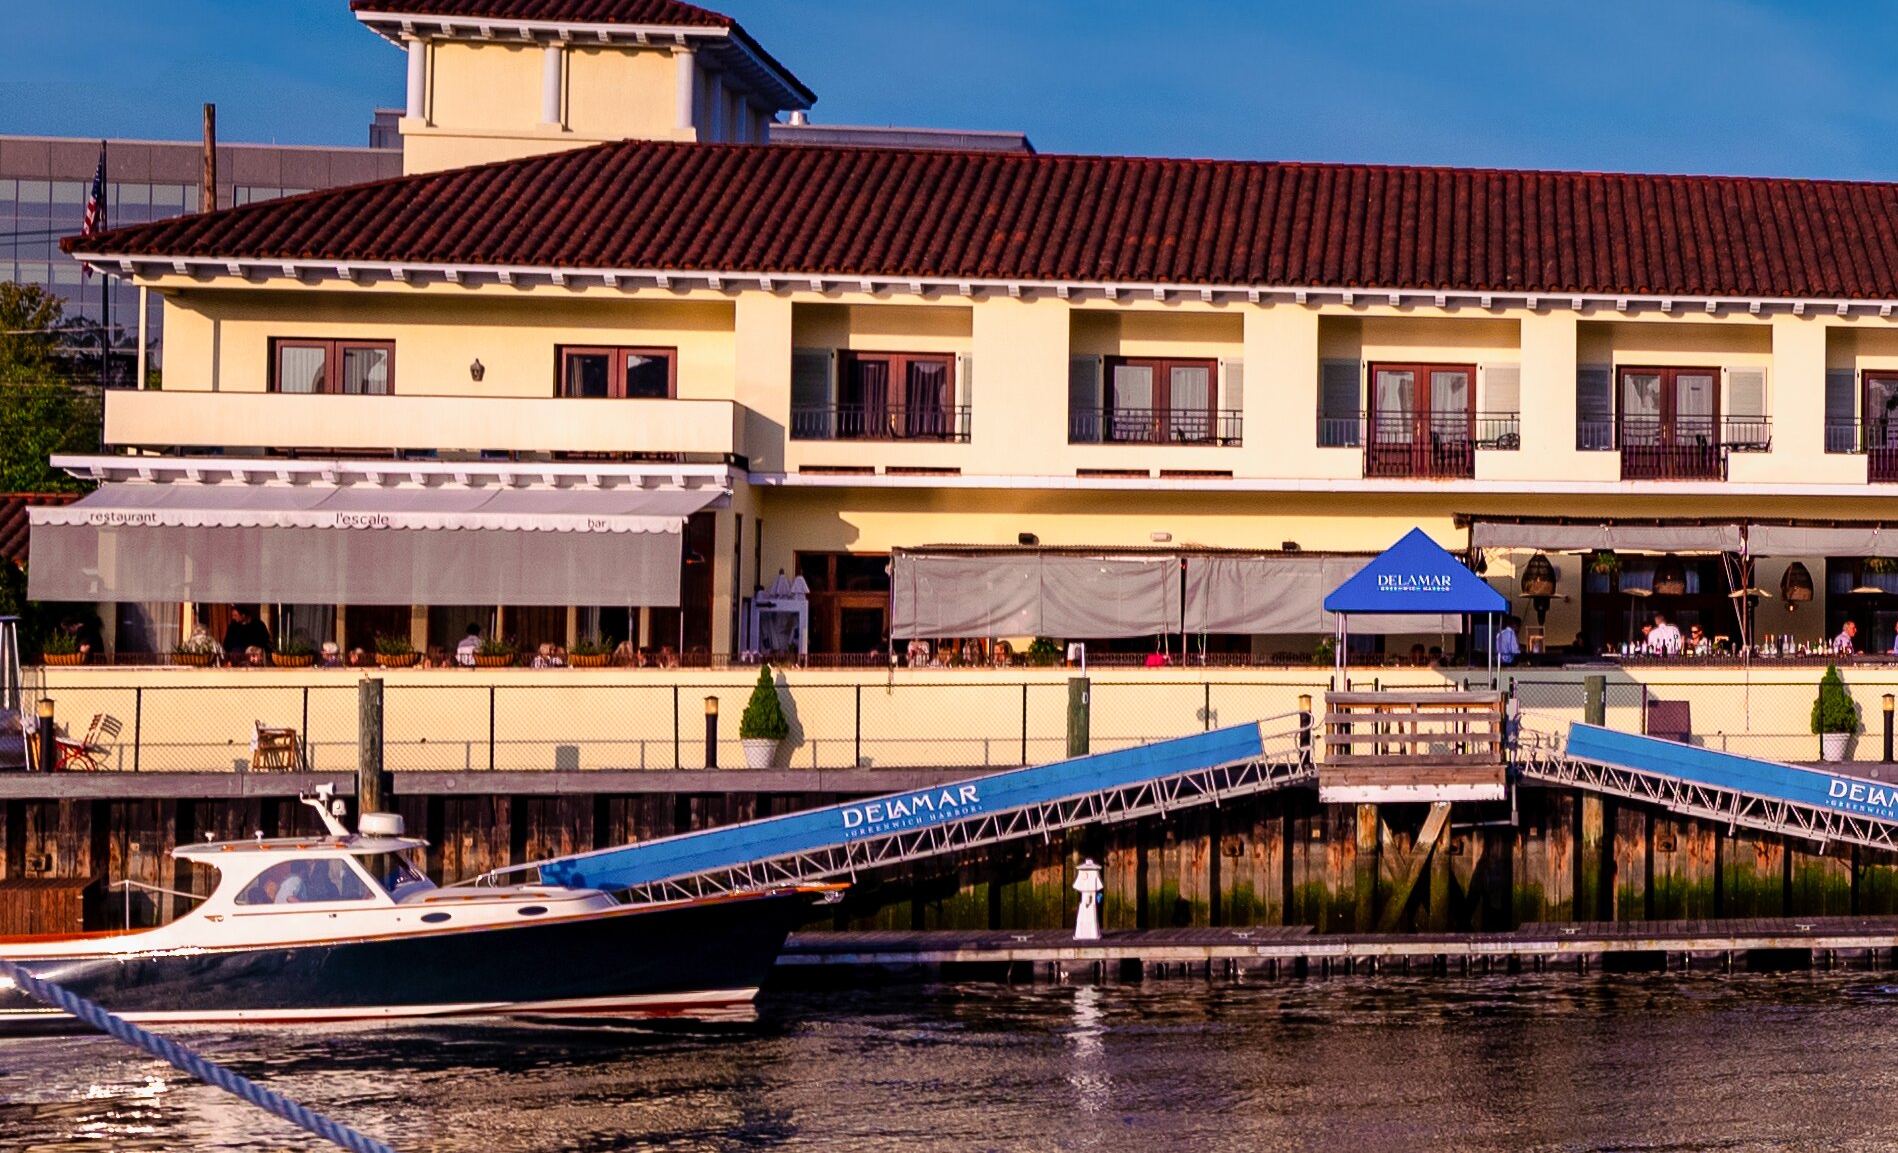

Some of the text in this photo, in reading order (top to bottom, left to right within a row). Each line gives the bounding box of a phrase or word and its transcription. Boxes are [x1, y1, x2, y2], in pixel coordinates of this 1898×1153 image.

[90, 511, 606, 528] restaurant l'escale bar
[1377, 574, 1451, 586] DELAMAR
[841, 784, 981, 829] DELAMAR
[1830, 799, 1894, 817] GREENWICH
